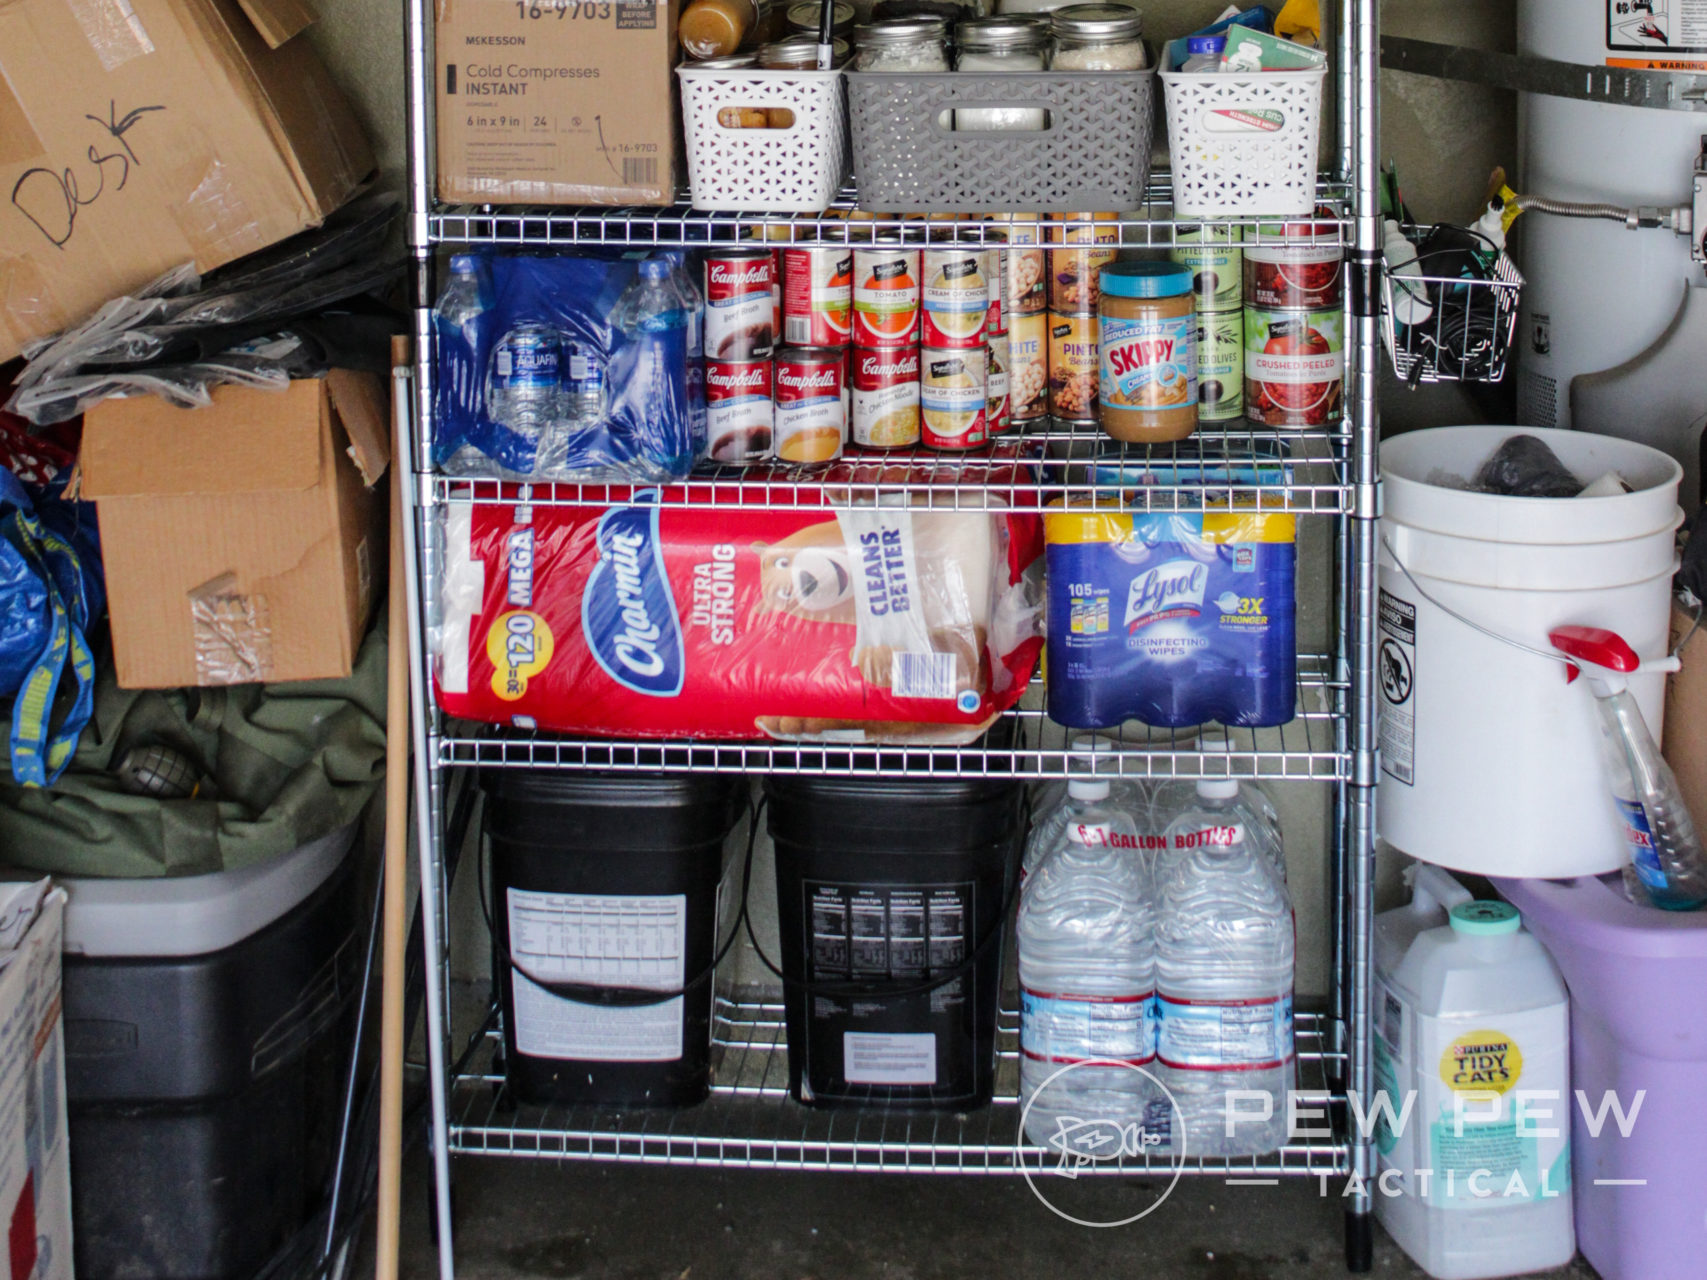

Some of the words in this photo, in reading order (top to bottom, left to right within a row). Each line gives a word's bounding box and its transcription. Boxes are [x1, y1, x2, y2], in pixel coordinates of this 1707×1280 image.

[516, 0, 611, 20] 16-9703
[466, 63, 502, 78] Cold
[507, 64, 600, 81] Compresses
[466, 83, 528, 95] INSTANT
[467, 117, 473, 126] 6
[477, 117, 487, 126] in
[500, 117, 506, 126] 9
[509, 117, 520, 126] in
[533, 117, 547, 126] 24
[619, 144, 657, 152] 16-9703
[1009, 341, 1038, 354] HITE
[1109, 339, 1174, 377] SKIPPY
[1211, 353, 1237, 363] OLIVES
[1256, 359, 1300, 370] CRUSHED
[1302, 359, 1335, 369] PEELED
[509, 530, 533, 606] MEGA
[860, 532, 888, 616] CLEANS
[883, 529, 910, 613] BETTER
[693, 562, 712, 626] ULTRA
[711, 544, 736, 646] STRONG
[1068, 583, 1092, 596] 105
[1132, 566, 1202, 612] Lysol
[602, 531, 665, 677] Charmin
[1237, 598, 1264, 614] 3X
[1219, 615, 1268, 624] STRONGER
[507, 615, 534, 667] 120
[1128, 637, 1206, 647] DISINFECTING
[1149, 647, 1185, 655] WIPES
[1110, 831, 1167, 850] GALLON
[1175, 826, 1236, 849] BOTTLES
[1463, 1044, 1508, 1054] PURINA
[1454, 1054, 1506, 1070] TIDY
[1452, 1069, 1509, 1084] CATS
